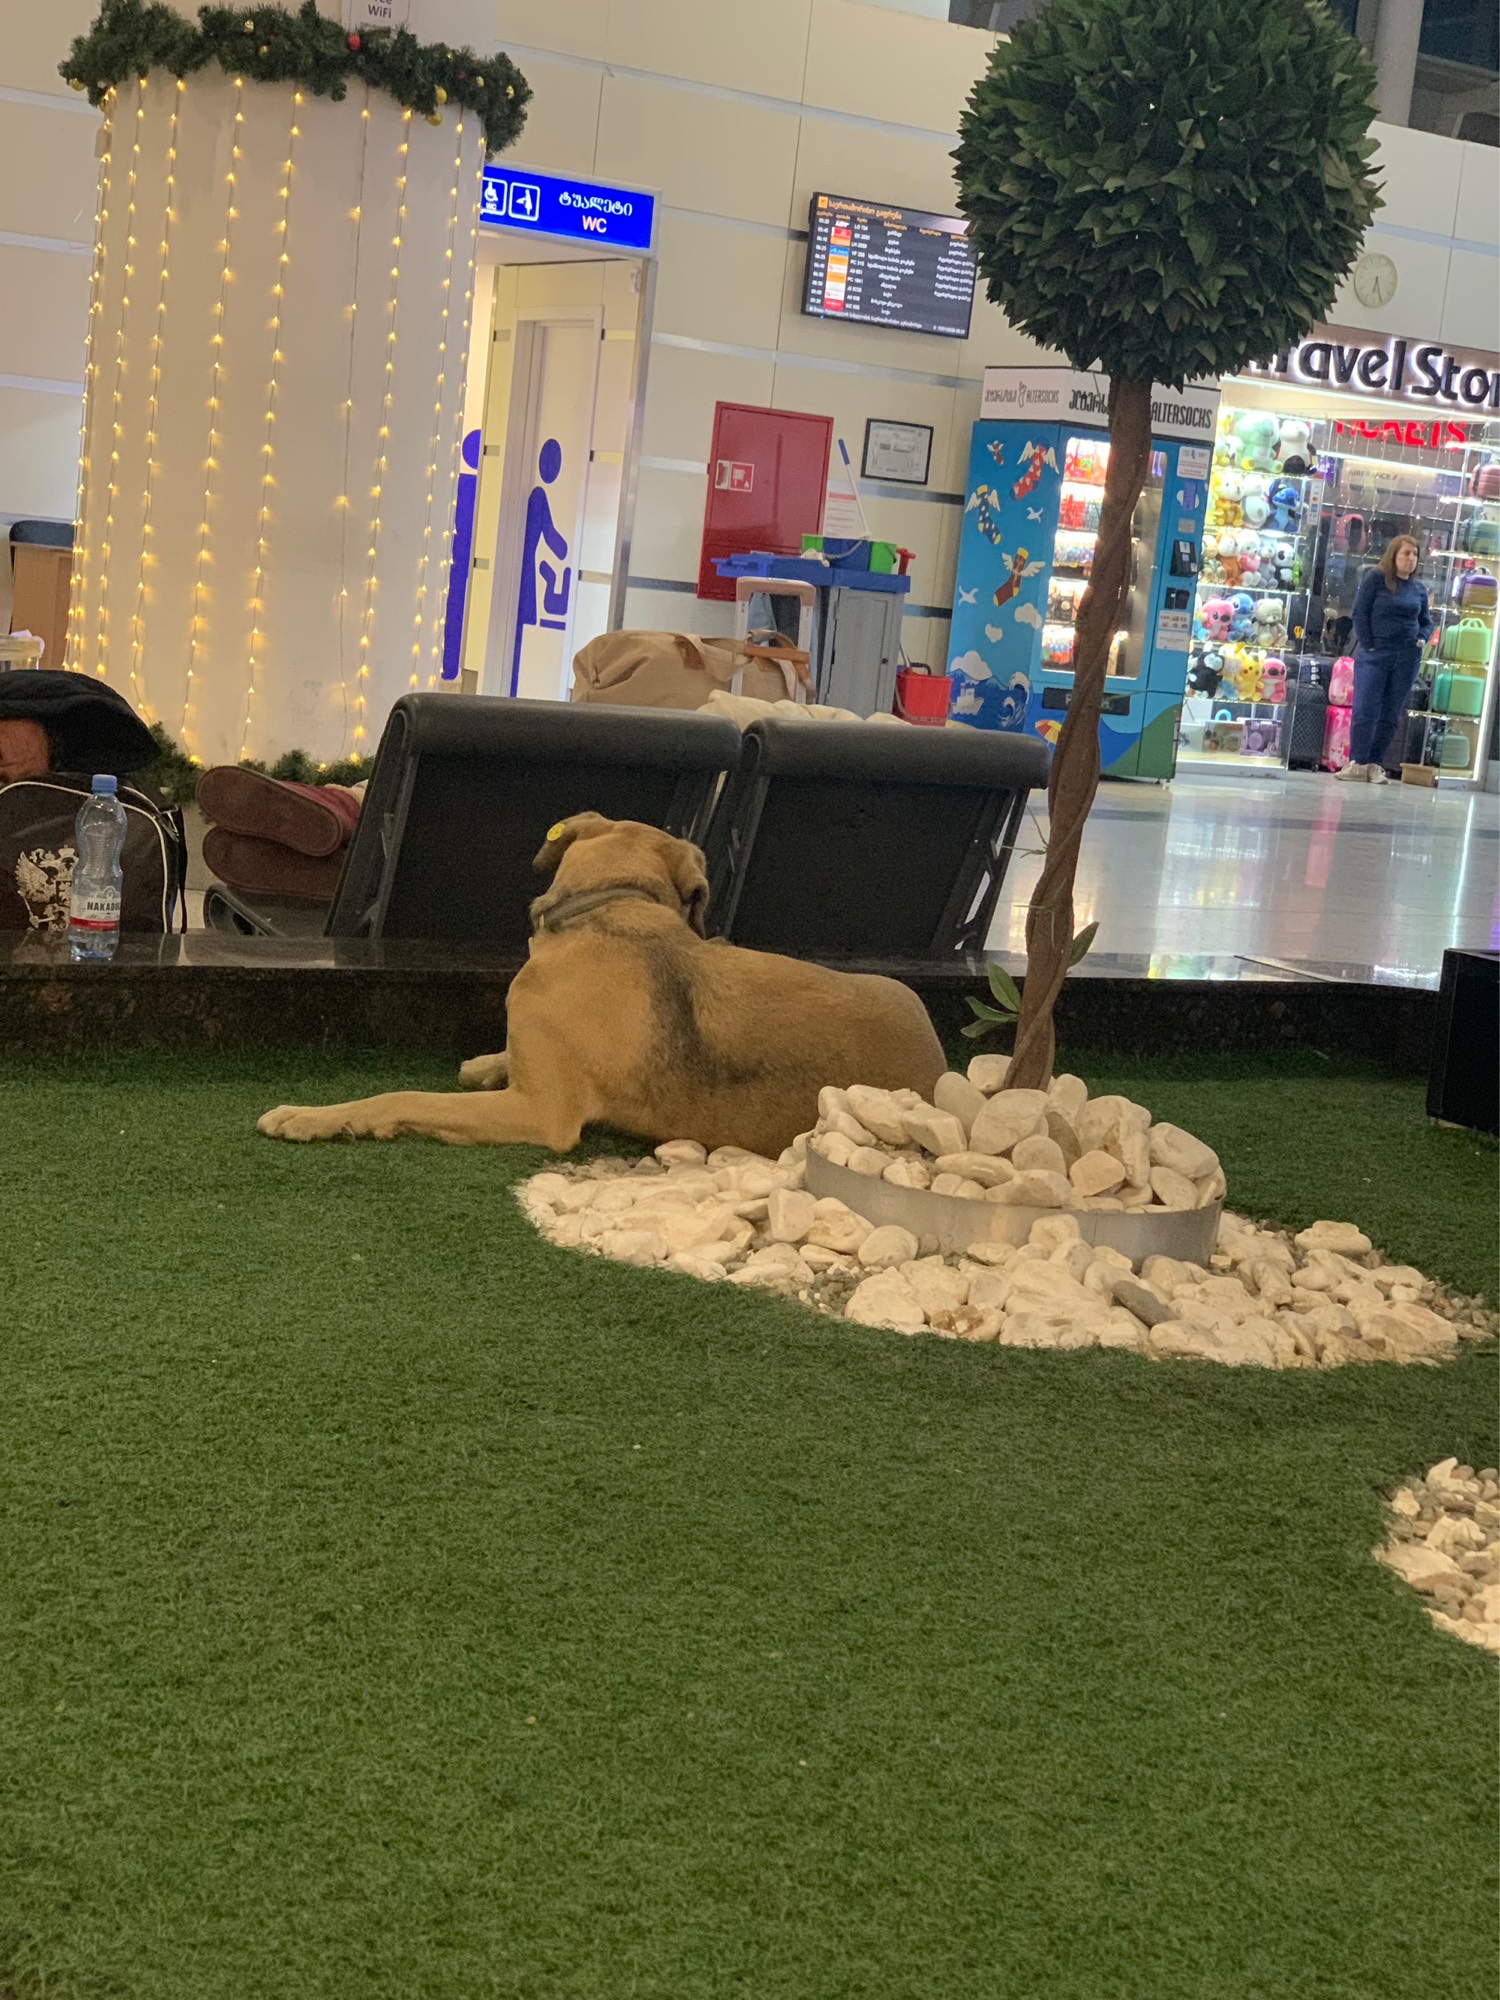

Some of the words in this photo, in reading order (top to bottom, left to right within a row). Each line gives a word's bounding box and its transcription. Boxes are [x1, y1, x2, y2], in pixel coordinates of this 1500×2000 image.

[368, 4, 392, 18] WiFi
[558, 191, 633, 216] ტუალეტი
[582, 215, 607, 234] WC
[1255, 340, 1406, 391] ravel
